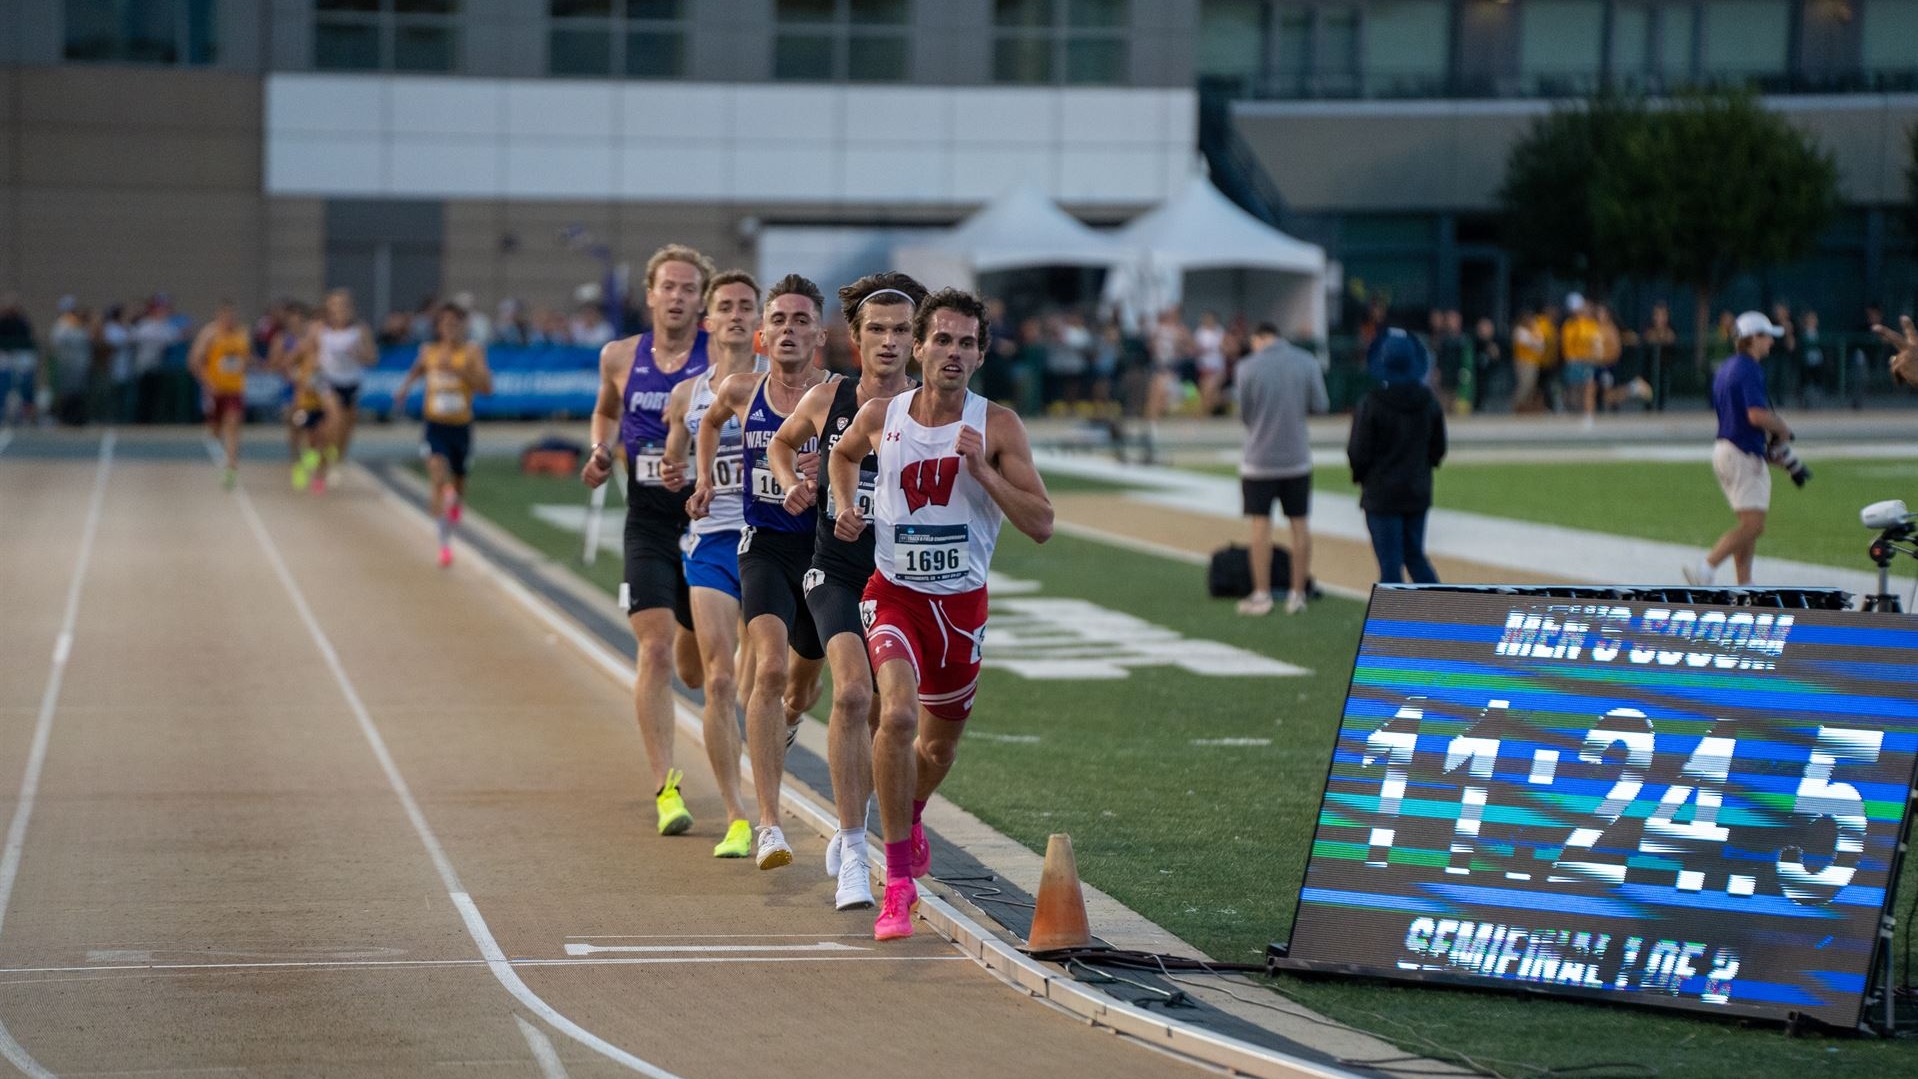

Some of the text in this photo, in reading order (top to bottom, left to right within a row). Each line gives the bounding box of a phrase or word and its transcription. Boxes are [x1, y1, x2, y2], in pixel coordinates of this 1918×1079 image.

[900, 456, 960, 516] W
[906, 548, 960, 572] 1696
[1362, 696, 1885, 906] 11:24.5
[1396, 916, 1611, 989] SEMIFINAL
